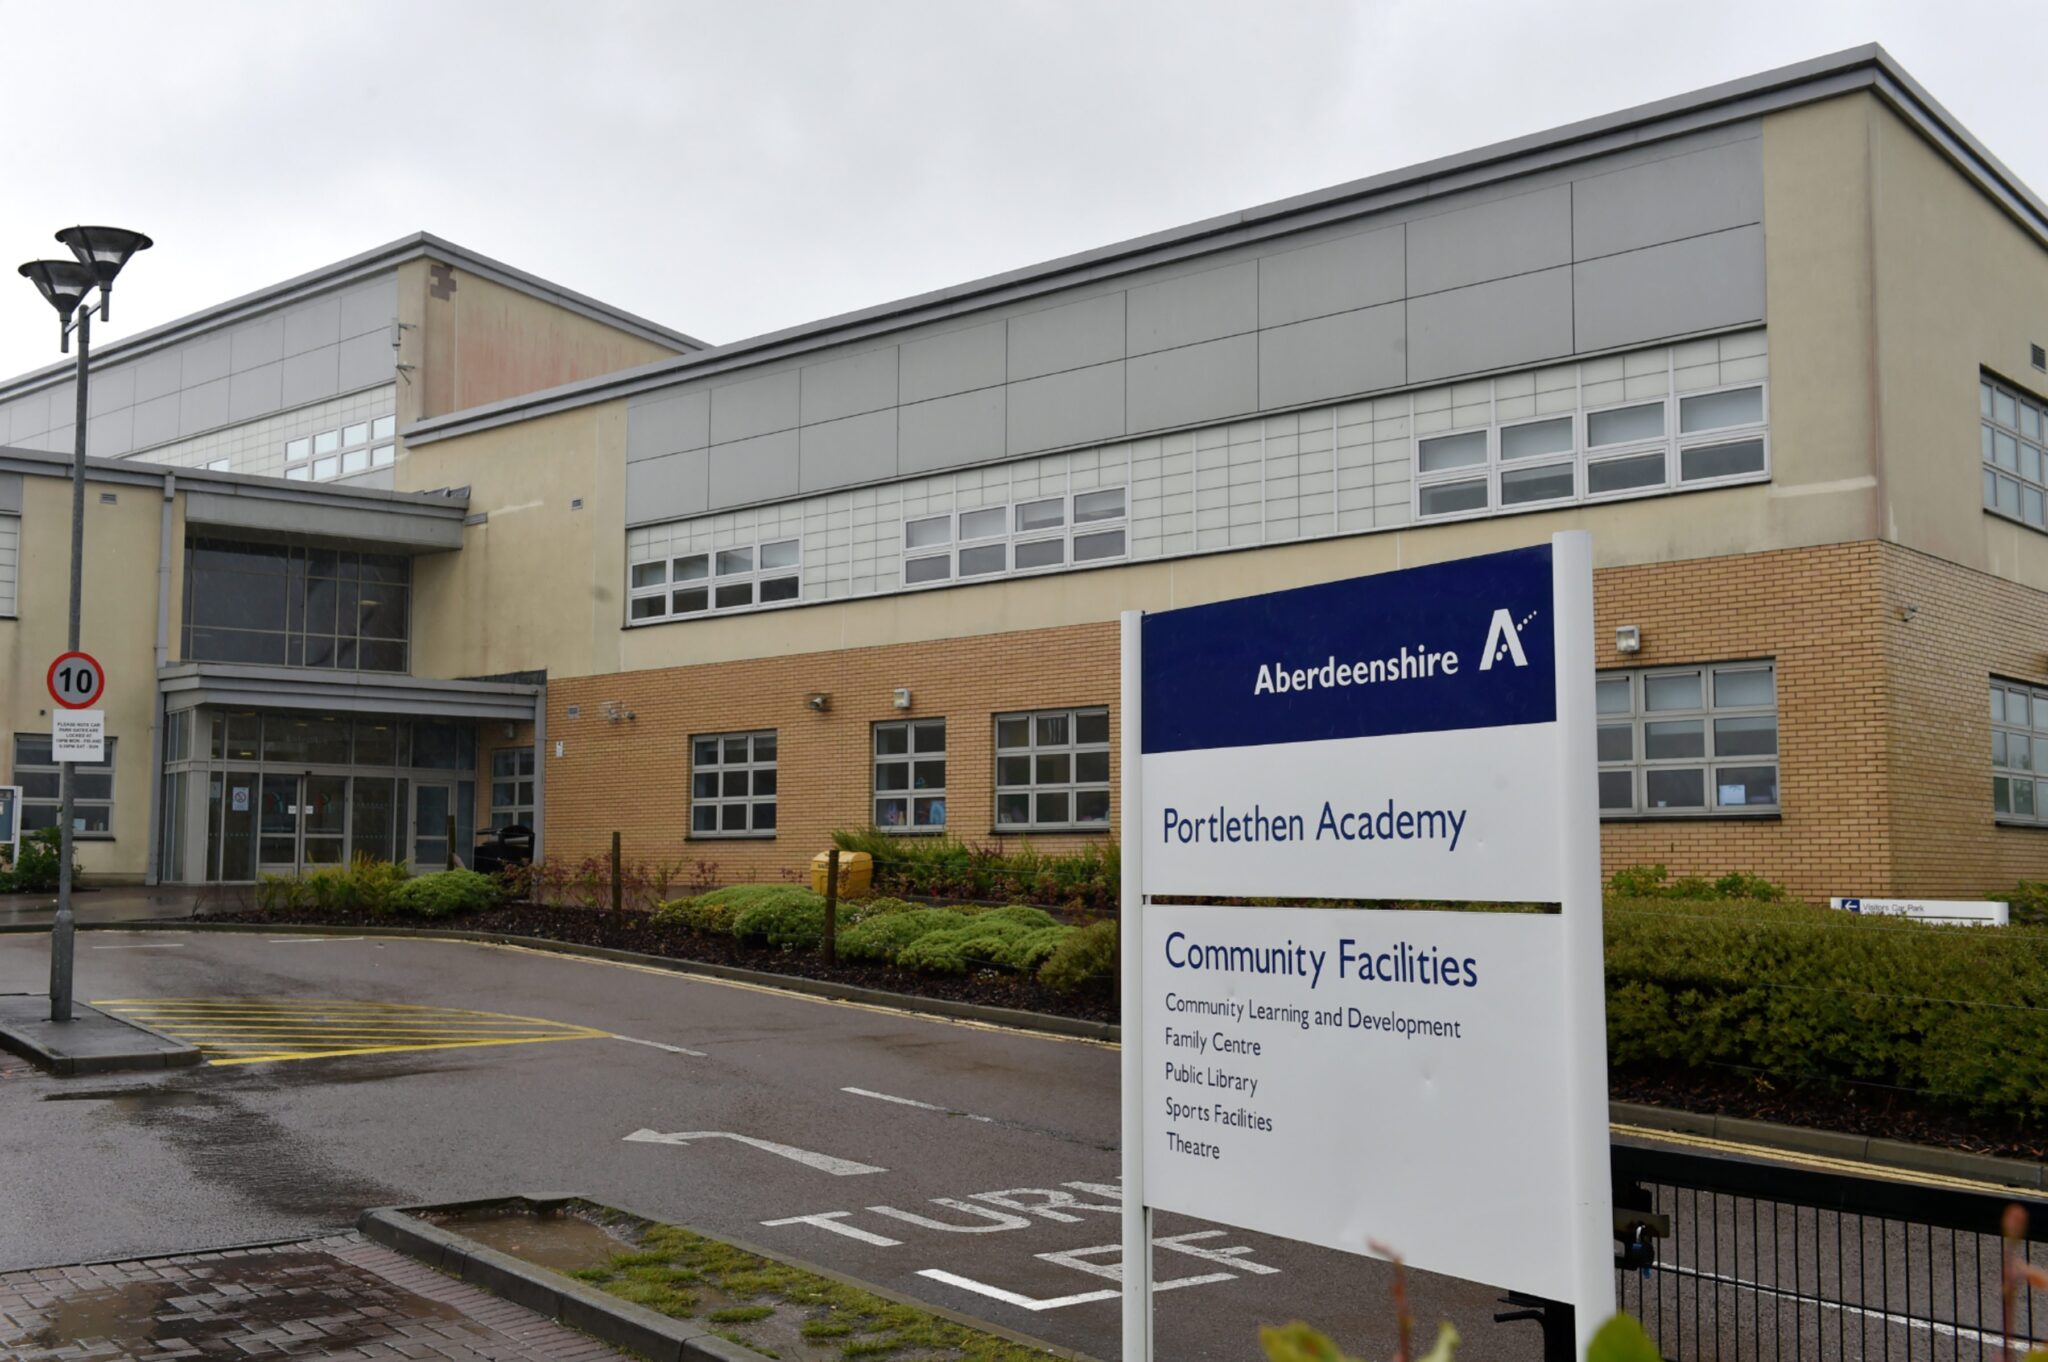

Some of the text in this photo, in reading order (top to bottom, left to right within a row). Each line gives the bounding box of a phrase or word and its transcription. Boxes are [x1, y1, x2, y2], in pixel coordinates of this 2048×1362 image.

[59, 667, 92, 694] 10
[1254, 644, 1458, 695] Aberdeenshire
[1163, 799, 1467, 851] Portlethen Academy
[1863, 903, 1889, 911] Visitors
[1891, 904, 1905, 912] Car
[1165, 931, 1478, 989] Community Facilities
[1165, 993, 1461, 1040] Community Learning and Development
[1165, 1027, 1261, 1056] Family Centre
[1165, 1062, 1258, 1098] Public Library
[1165, 1097, 1273, 1132] Sports Facilities
[1166, 1131, 1220, 1160] Theatre
